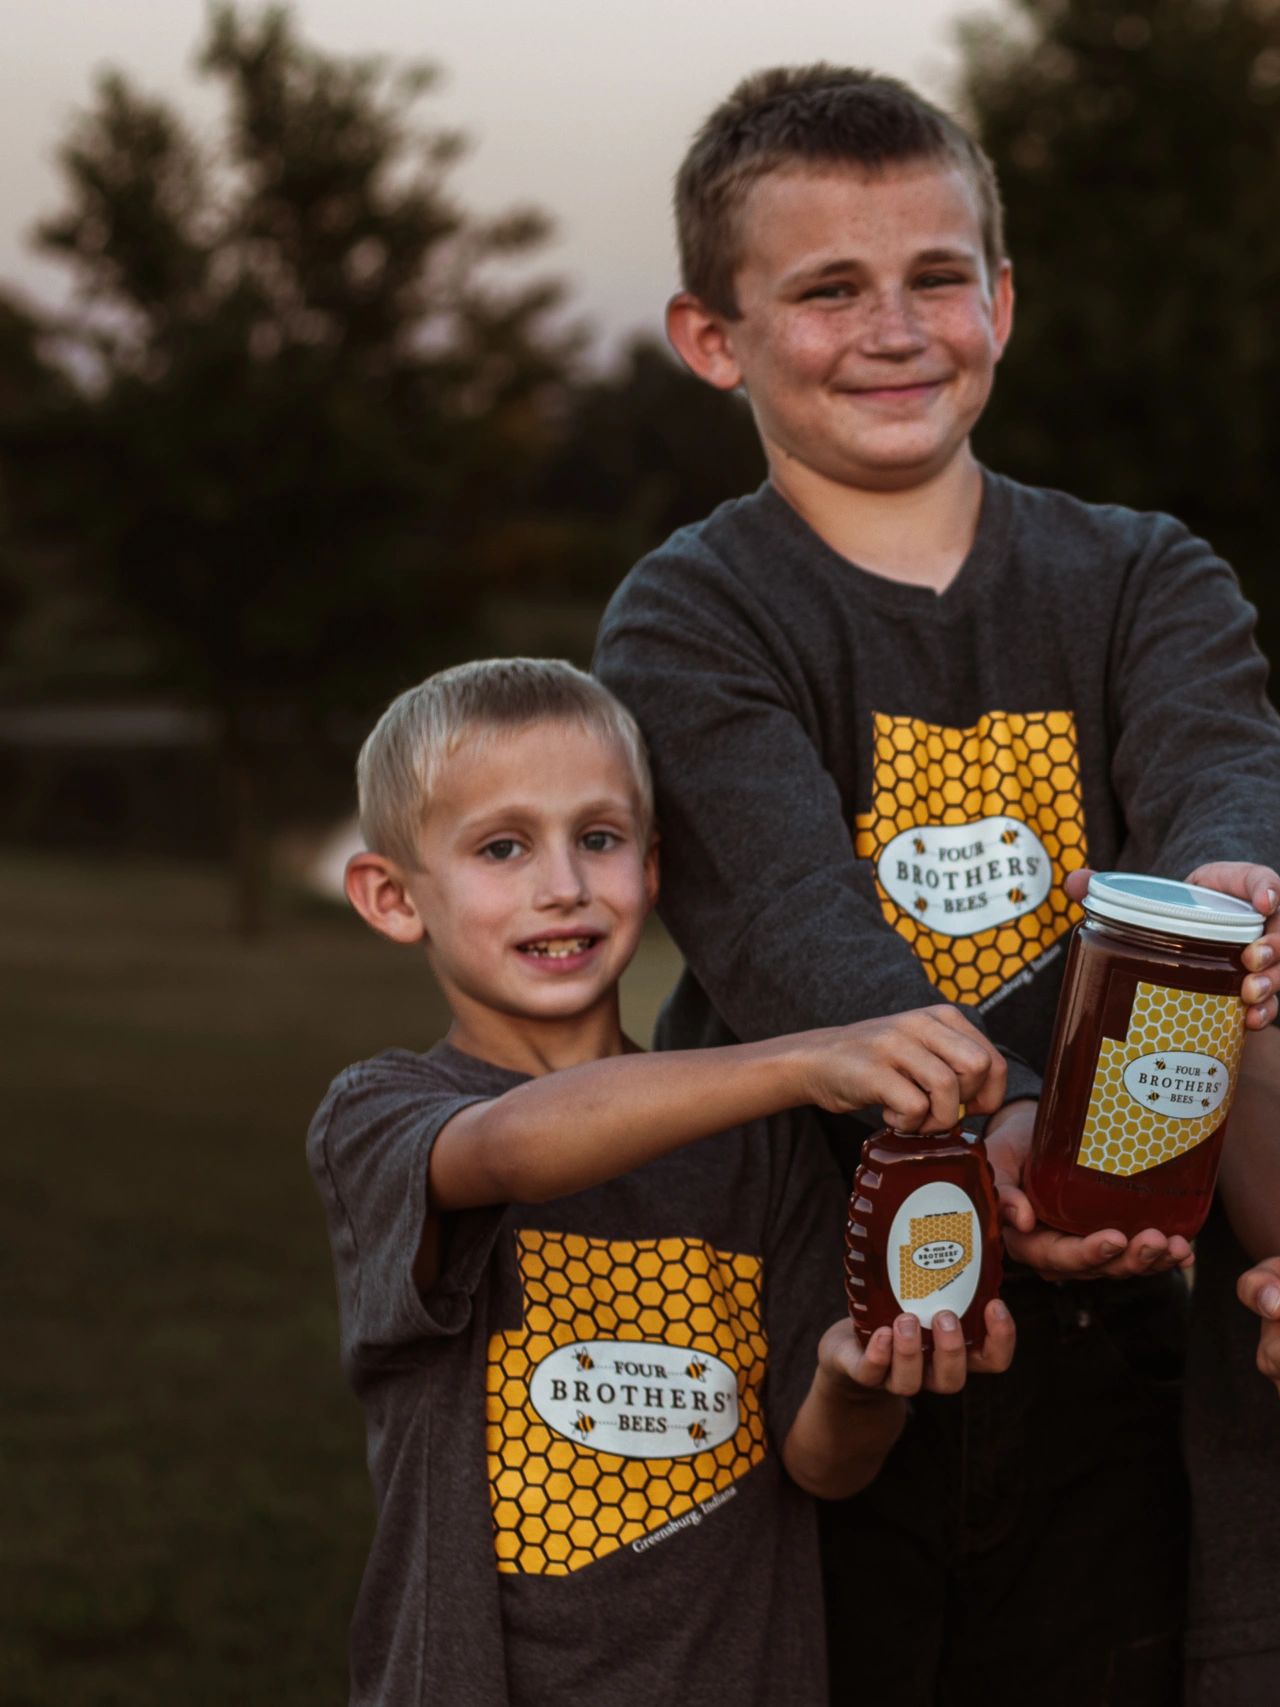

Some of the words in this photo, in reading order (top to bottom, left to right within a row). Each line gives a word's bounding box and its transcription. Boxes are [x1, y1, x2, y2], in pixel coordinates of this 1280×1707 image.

[938, 842, 985, 862] FOUR
[943, 892, 988, 913] BEES
[1175, 1065, 1201, 1076] FOUR
[1170, 1094, 1194, 1104] BEES
[613, 1361, 668, 1379] FOUR
[550, 1379, 733, 1413] BROTHERS'
[618, 1414, 667, 1433] BEES
[632, 1510, 702, 1553] Greensburg,
